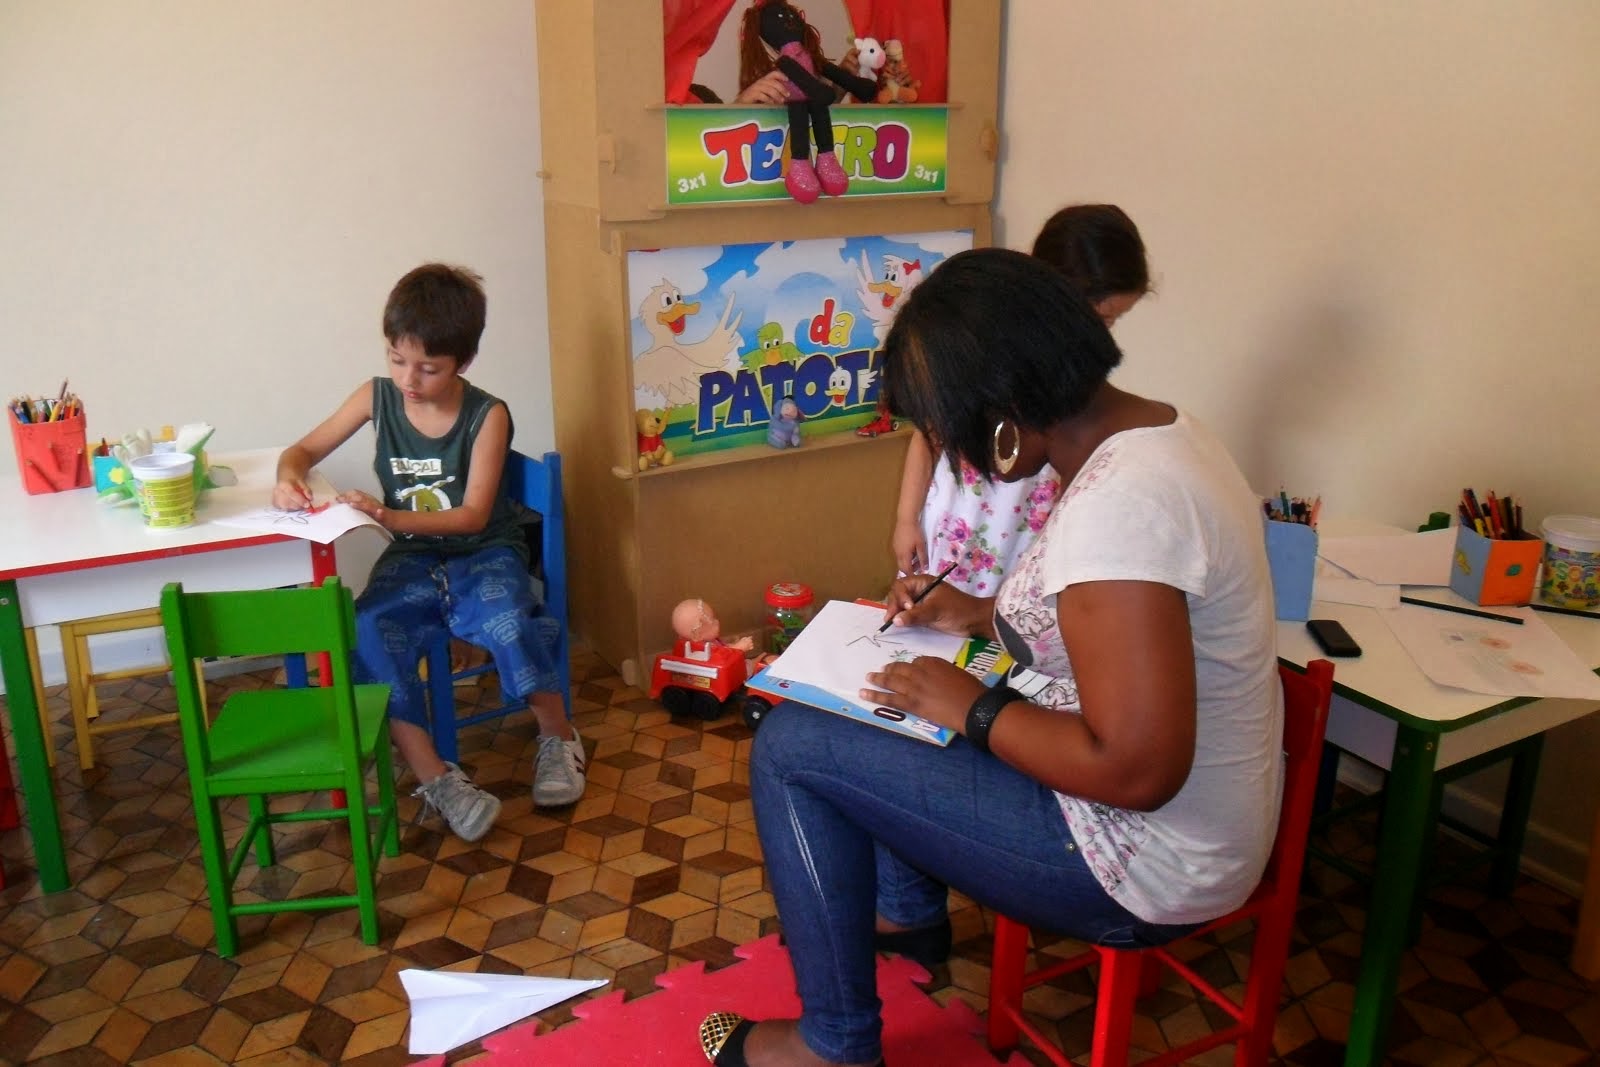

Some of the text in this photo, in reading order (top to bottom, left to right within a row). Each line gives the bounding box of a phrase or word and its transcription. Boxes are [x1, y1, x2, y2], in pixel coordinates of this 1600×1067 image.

[703, 122, 910, 184] TERO
[677, 171, 707, 193] 3x1
[914, 164, 939, 183] 3x1
[809, 298, 855, 347] da
